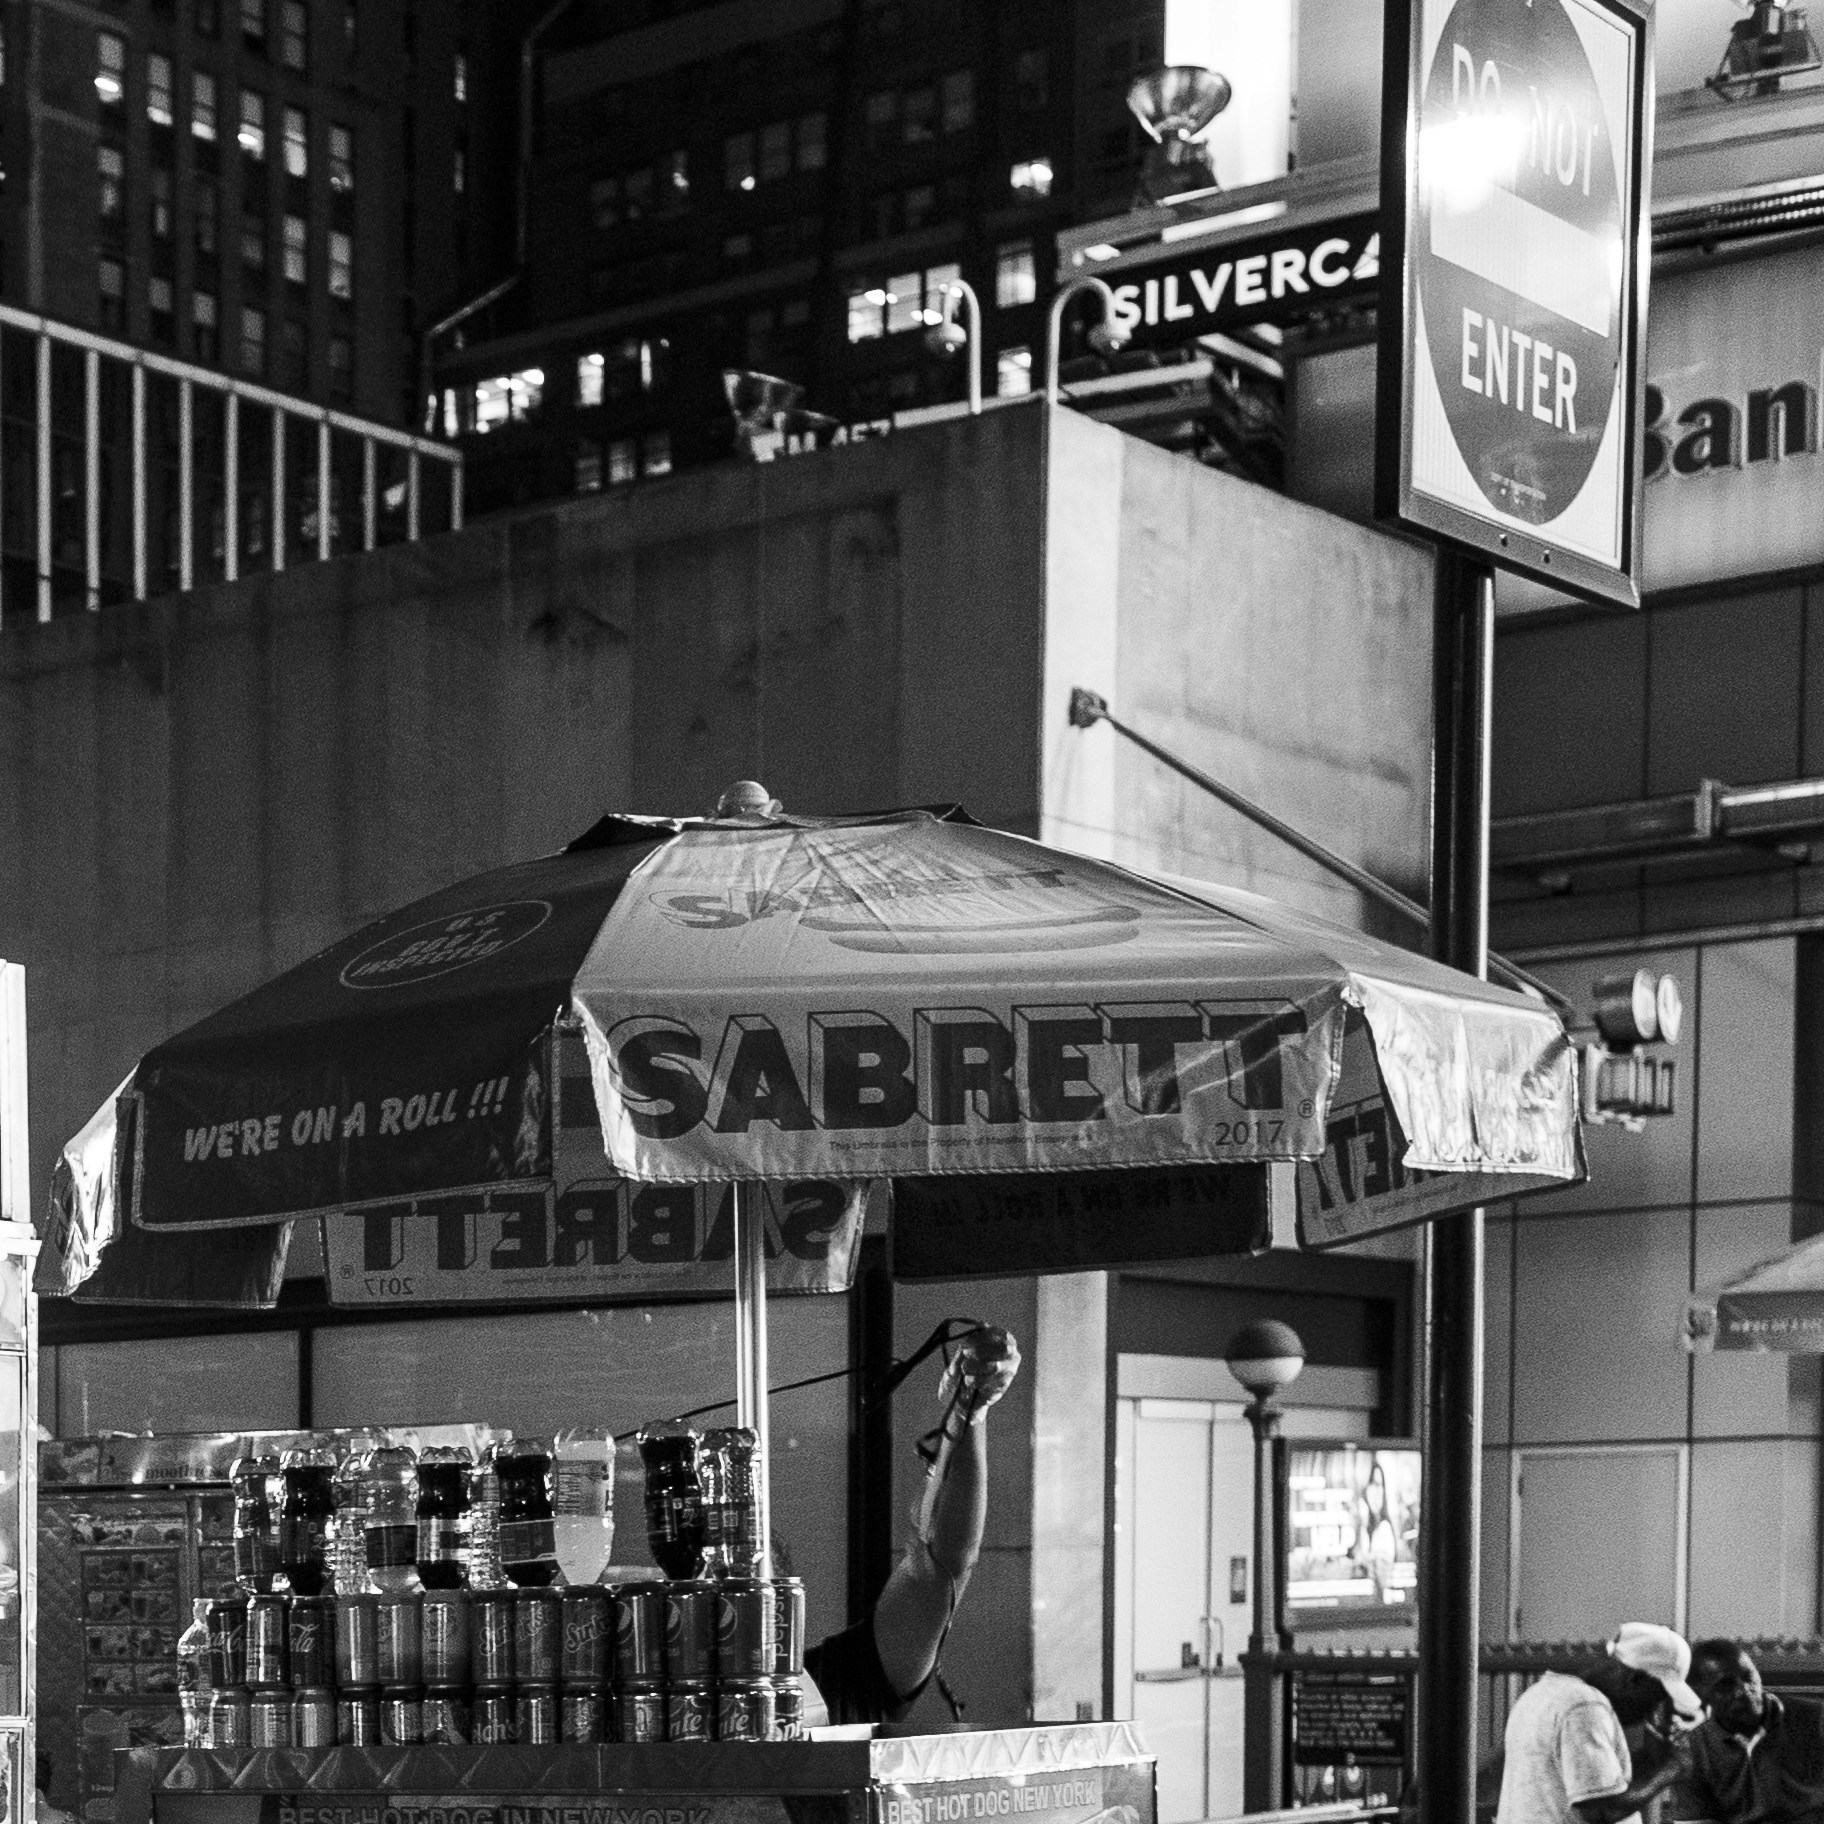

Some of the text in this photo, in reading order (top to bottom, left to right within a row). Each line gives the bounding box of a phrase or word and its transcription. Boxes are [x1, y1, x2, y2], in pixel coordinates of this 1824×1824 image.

[1528, 85, 1600, 197] NOT
[1462, 307, 1578, 434] ENTER
[1644, 378, 1824, 477] Ban
[606, 998, 1307, 1140] SABRETT
[184, 1113, 283, 1163] WE'RE
[290, 1104, 337, 1147] ON
[342, 1101, 366, 1138] A
[378, 1088, 458, 1136] ROLL
[1213, 1120, 1285, 1148] 2017
[936, 1793, 972, 1822] HOT
[976, 1788, 1010, 1818] DOG
[1013, 1784, 1052, 1812] NEW
[1053, 1781, 1096, 1808] YORK
